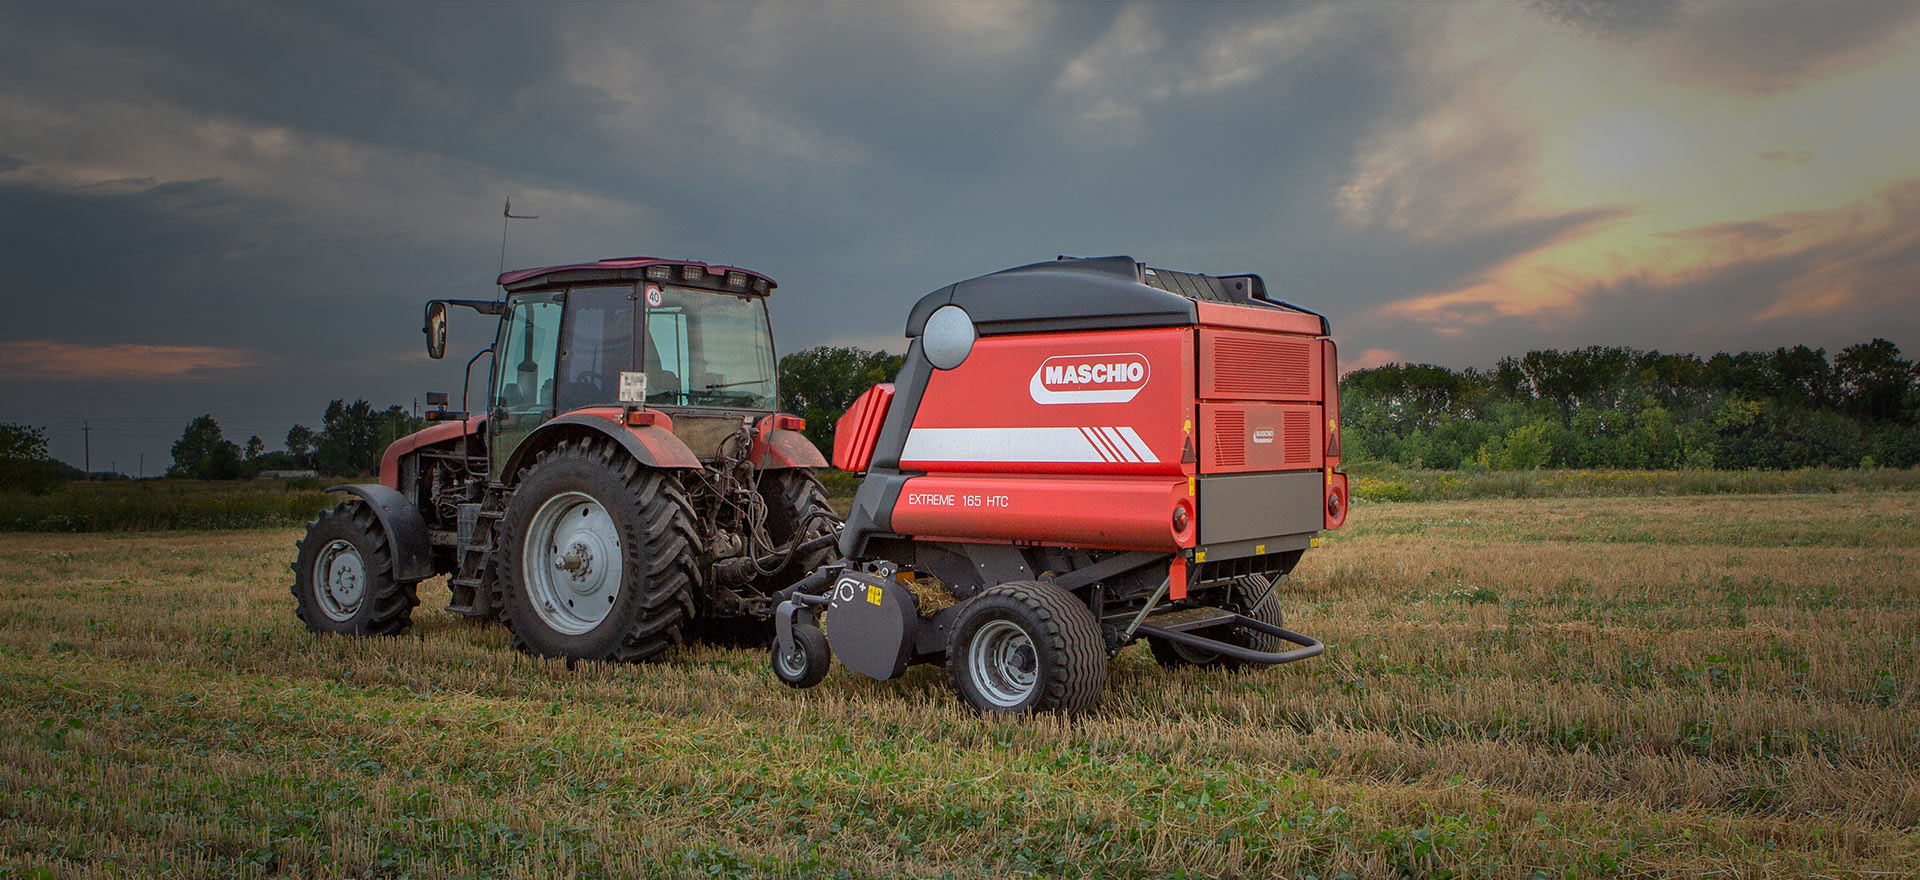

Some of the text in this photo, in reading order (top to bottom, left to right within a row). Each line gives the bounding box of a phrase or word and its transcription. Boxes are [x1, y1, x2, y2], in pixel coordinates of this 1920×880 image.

[649, 291, 660, 303] 40
[1045, 362, 1144, 385] MASCHIO
[908, 493, 1009, 508] EXTREME 165 HTC
